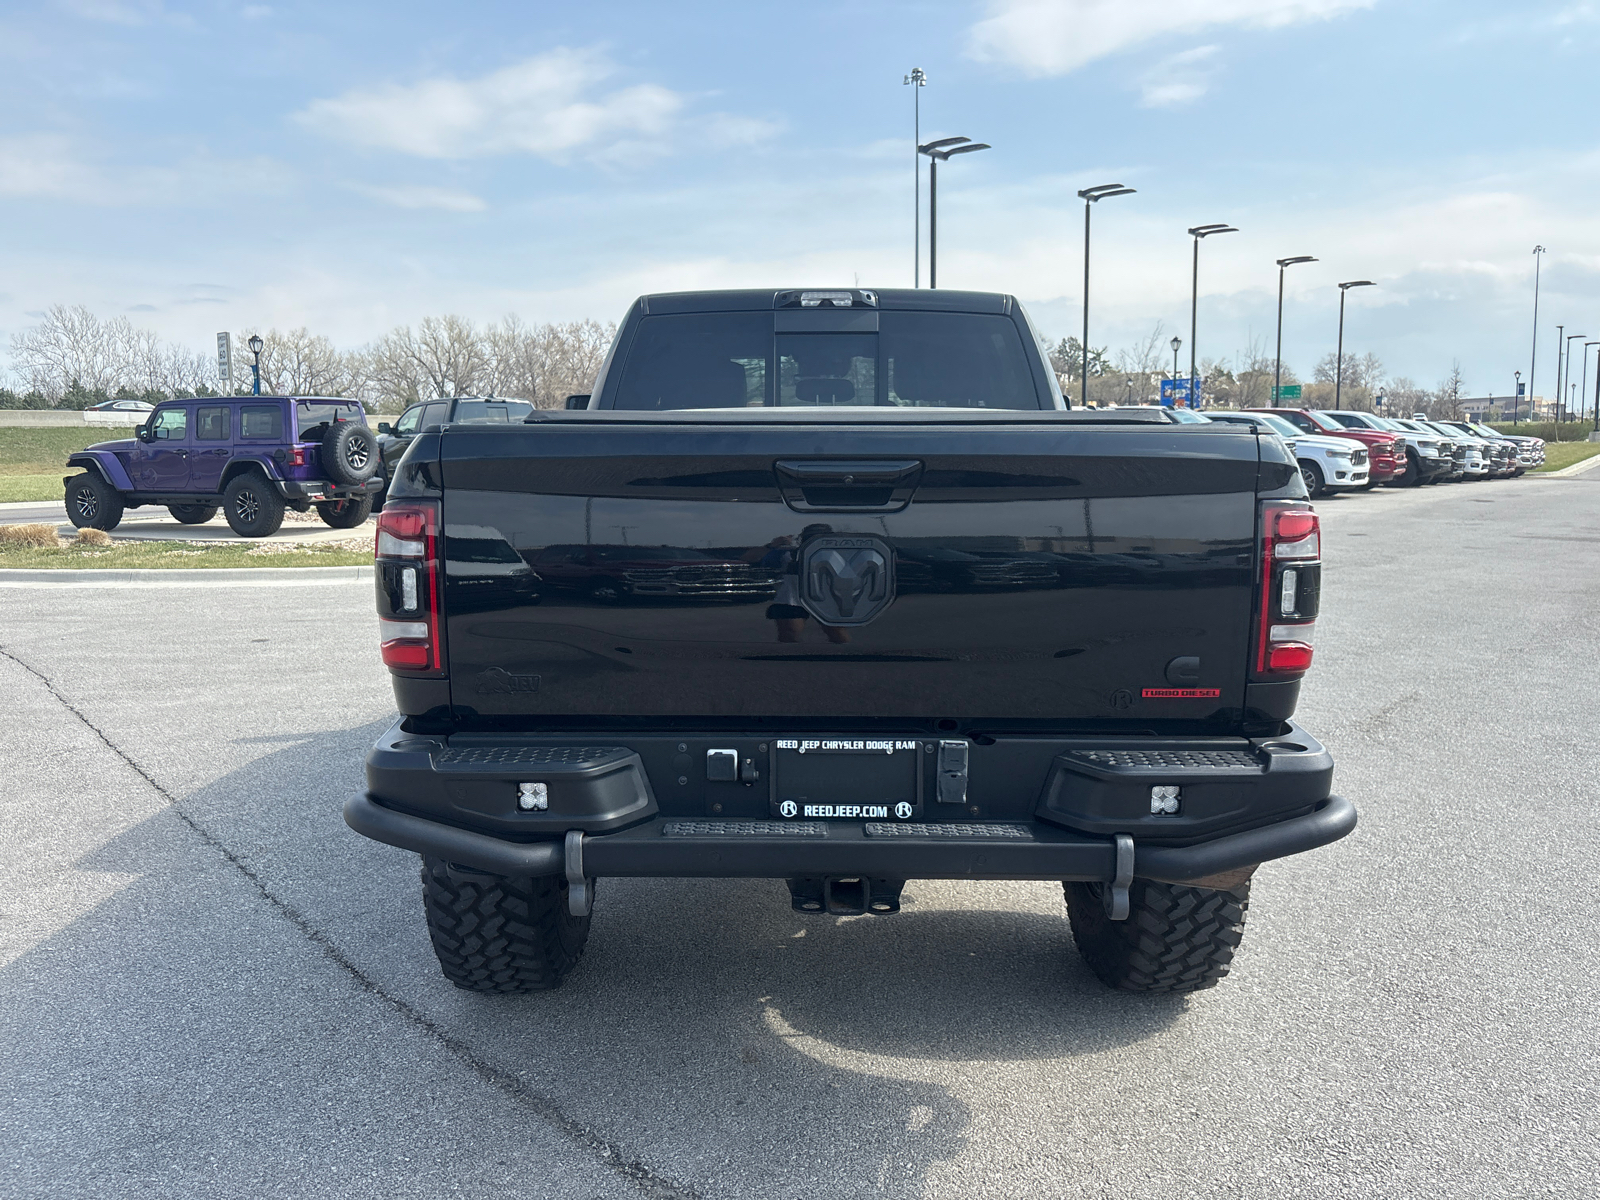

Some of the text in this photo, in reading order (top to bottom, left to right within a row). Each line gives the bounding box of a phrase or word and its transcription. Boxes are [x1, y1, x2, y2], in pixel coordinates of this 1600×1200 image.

[220, 350, 226, 360] 60
[821, 539, 874, 547] RAM
[776, 740, 916, 750] REED JEEP CHRYSLER DODGE RAM
[804, 804, 888, 818] REEDJEEP.COM
